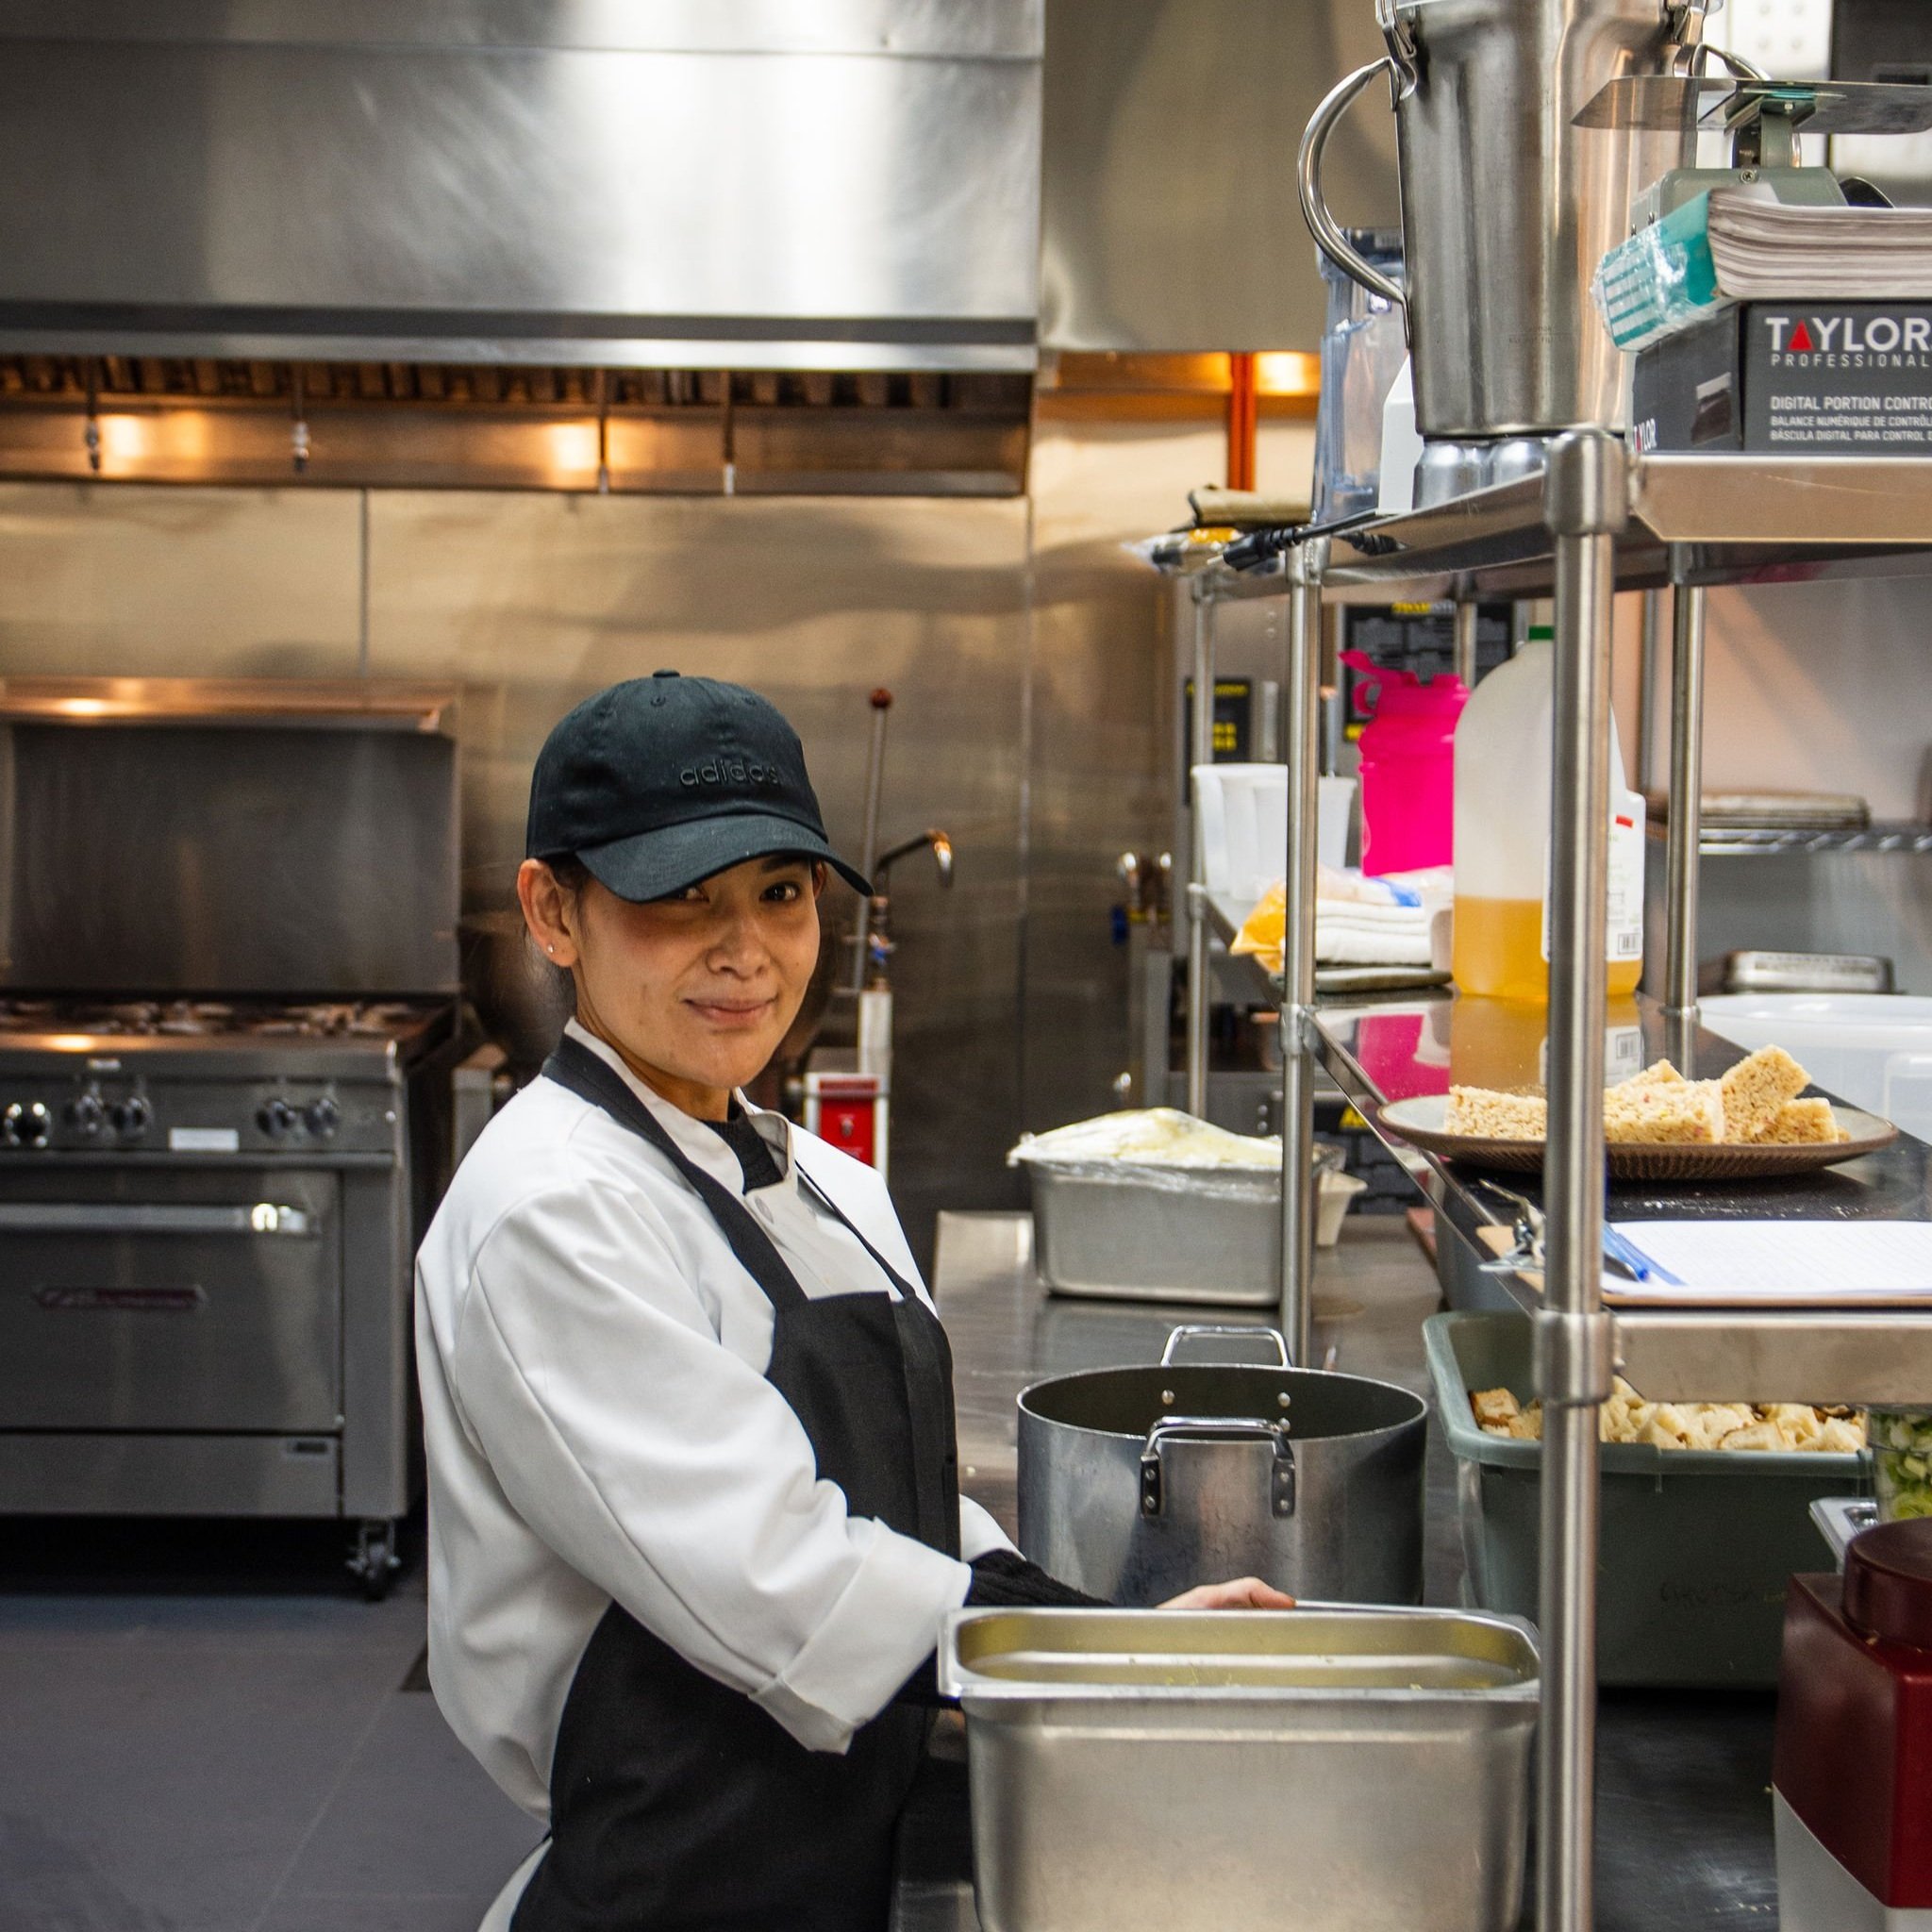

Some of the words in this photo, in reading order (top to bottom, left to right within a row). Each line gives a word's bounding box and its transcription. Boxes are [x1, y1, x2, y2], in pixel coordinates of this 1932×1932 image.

[1765, 317, 1930, 352] TAYLOR
[1771, 353, 1930, 367] PROFESSIONAL
[1770, 395, 1821, 410] DIGITAL
[1824, 395, 1881, 410] PORTION
[1770, 415, 1815, 427] BALANCE
[1874, 415, 1887, 427] DE
[1888, 414, 1932, 427] CONTRÔL
[1816, 429, 1852, 441] DIGITAL
[1854, 429, 1880, 441] PARA
[1882, 429, 1925, 441] CONTROL
[679, 758, 778, 786] adidas
